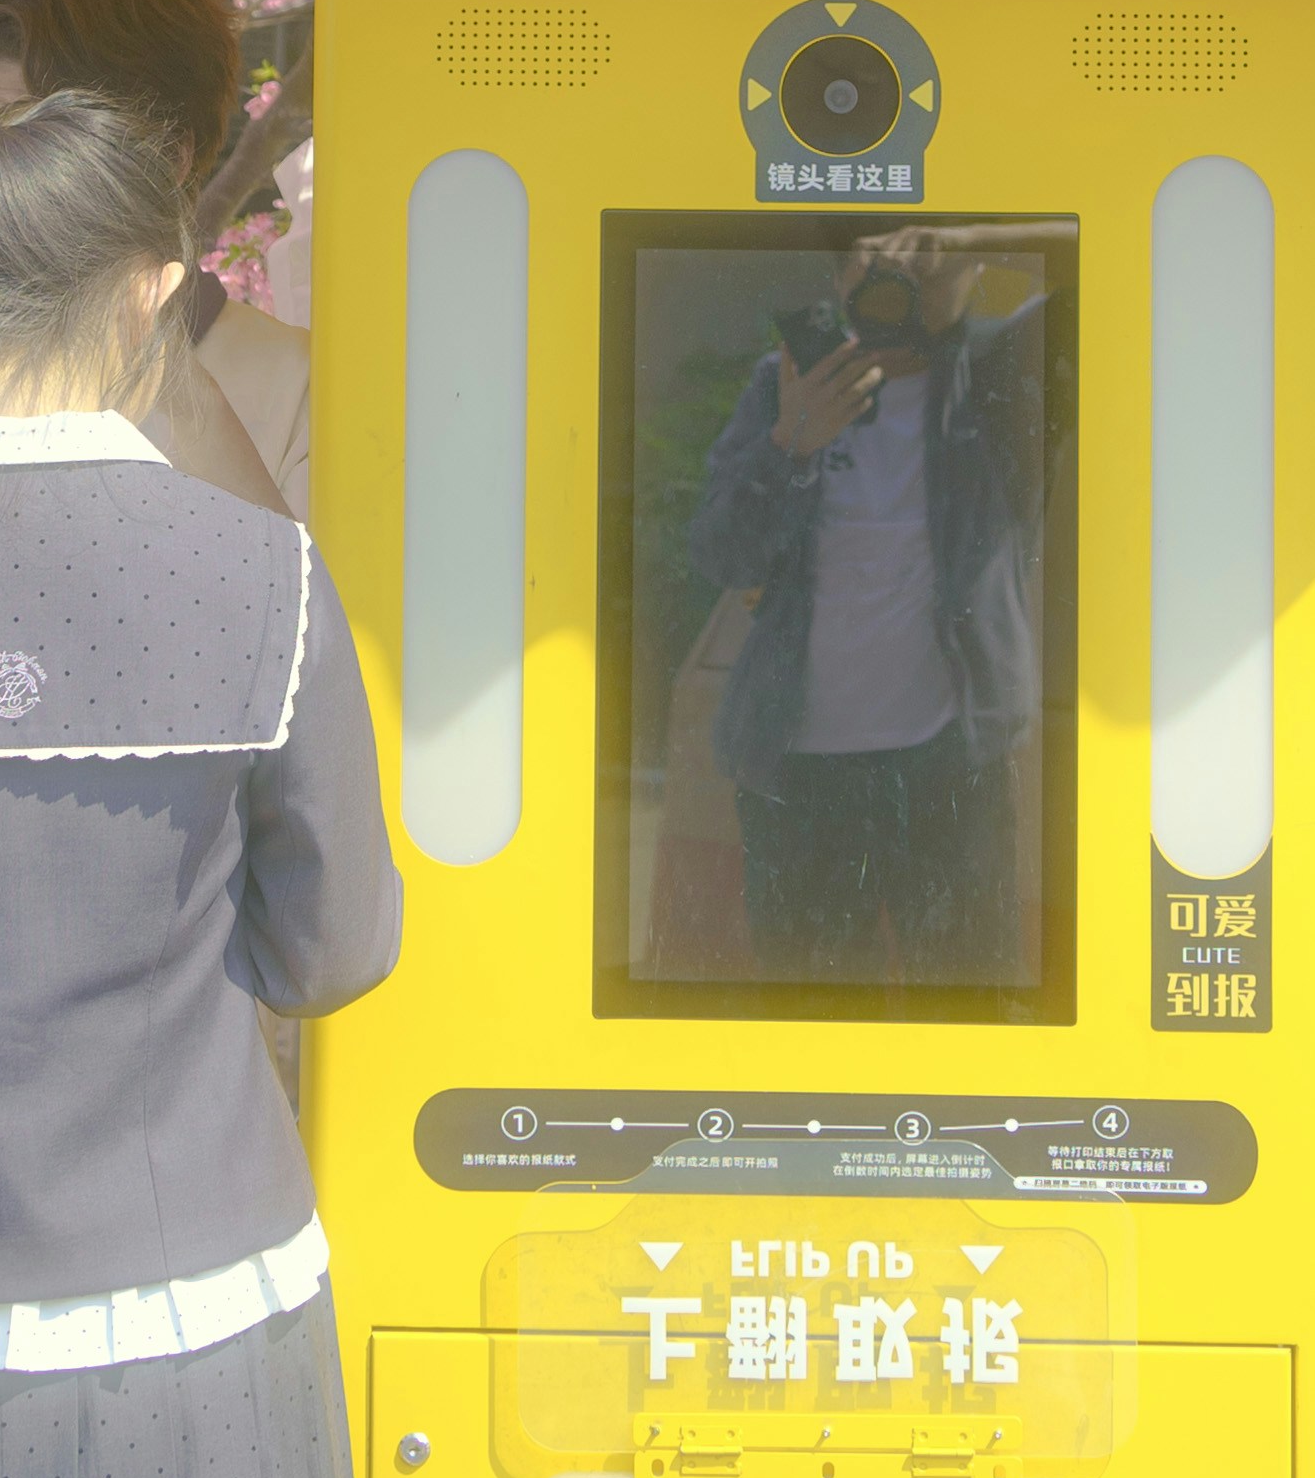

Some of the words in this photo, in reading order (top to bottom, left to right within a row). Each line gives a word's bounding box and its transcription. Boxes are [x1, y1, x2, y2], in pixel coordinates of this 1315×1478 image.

[767, 162, 914, 193] 镜头看这里
[1166, 893, 1257, 938] 可爱
[1182, 946, 1241, 964] CUTE
[1166, 972, 1257, 1018] 到报
[462, 1153, 577, 1166] 选择你喜欢的报纸款式
